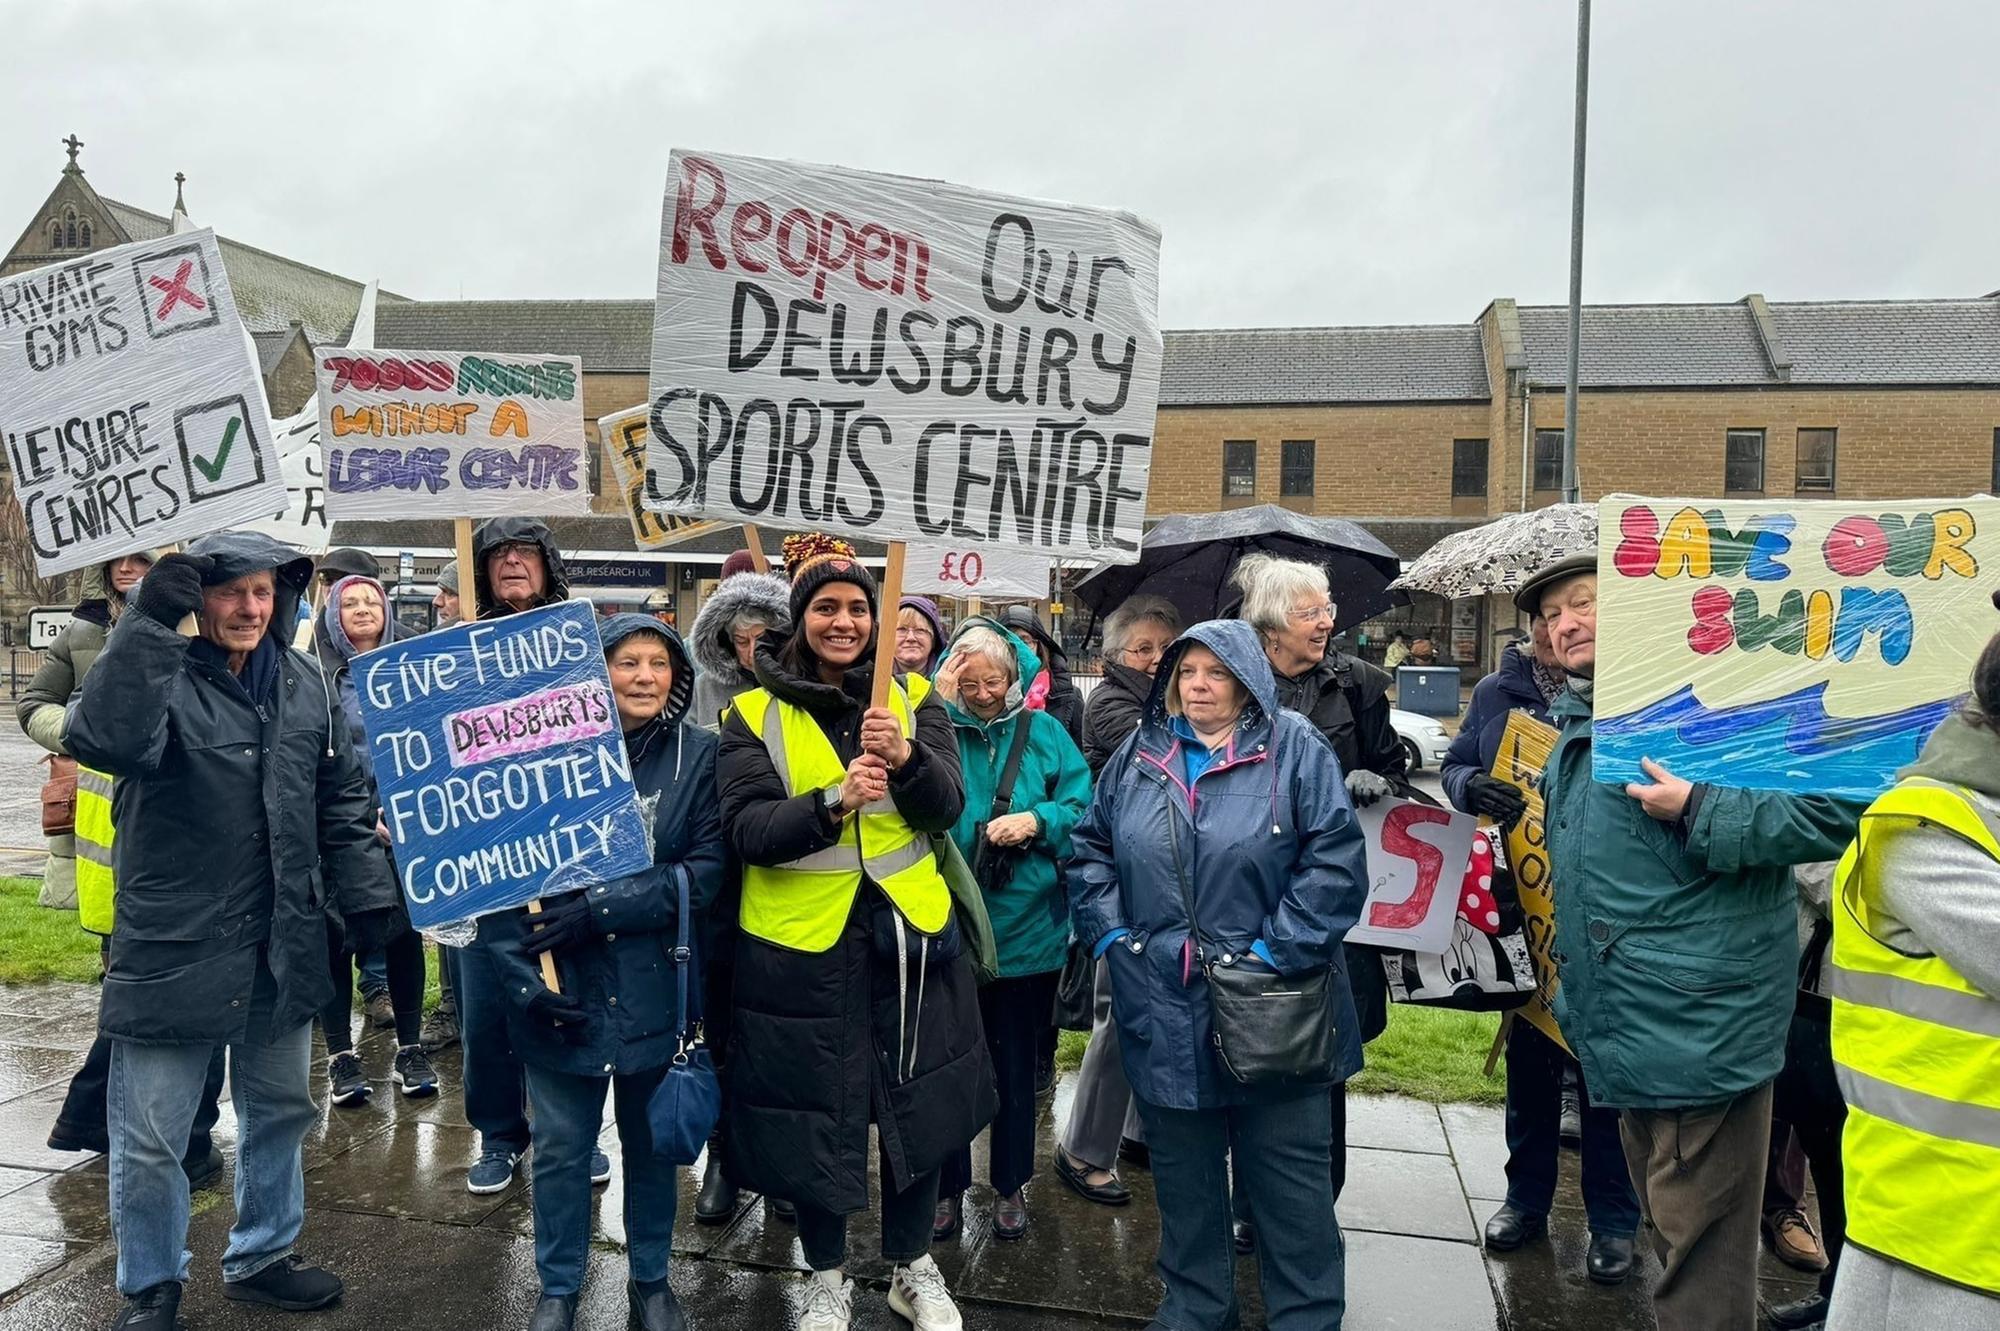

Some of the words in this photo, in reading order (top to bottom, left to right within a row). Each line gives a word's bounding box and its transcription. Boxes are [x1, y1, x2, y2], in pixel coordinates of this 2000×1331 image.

[670, 156, 934, 303] Reopen
[980, 212, 1136, 323] Our
[0, 259, 117, 327] RIVATE
[25, 305, 129, 372] GYMS
[728, 281, 1136, 416] DEWSBURY
[9, 402, 160, 488] LEISURE
[331, 402, 479, 437] WITHOUT
[490, 399, 529, 437] A
[459, 444, 581, 491] CENTRE
[645, 387, 892, 527] SPORTS
[912, 416, 1151, 553] CENTRE
[586, 567, 635, 577] RESEARCH
[638, 568, 651, 577] UK
[1614, 505, 1797, 581] SAVE
[1821, 508, 1980, 580] OUR
[37, 620, 72, 637] Tax
[469, 621, 588, 686] FUNDS
[1687, 585, 1914, 666] SWIM
[376, 727, 432, 777] TO
[390, 741, 631, 844] FORGOTTEN
